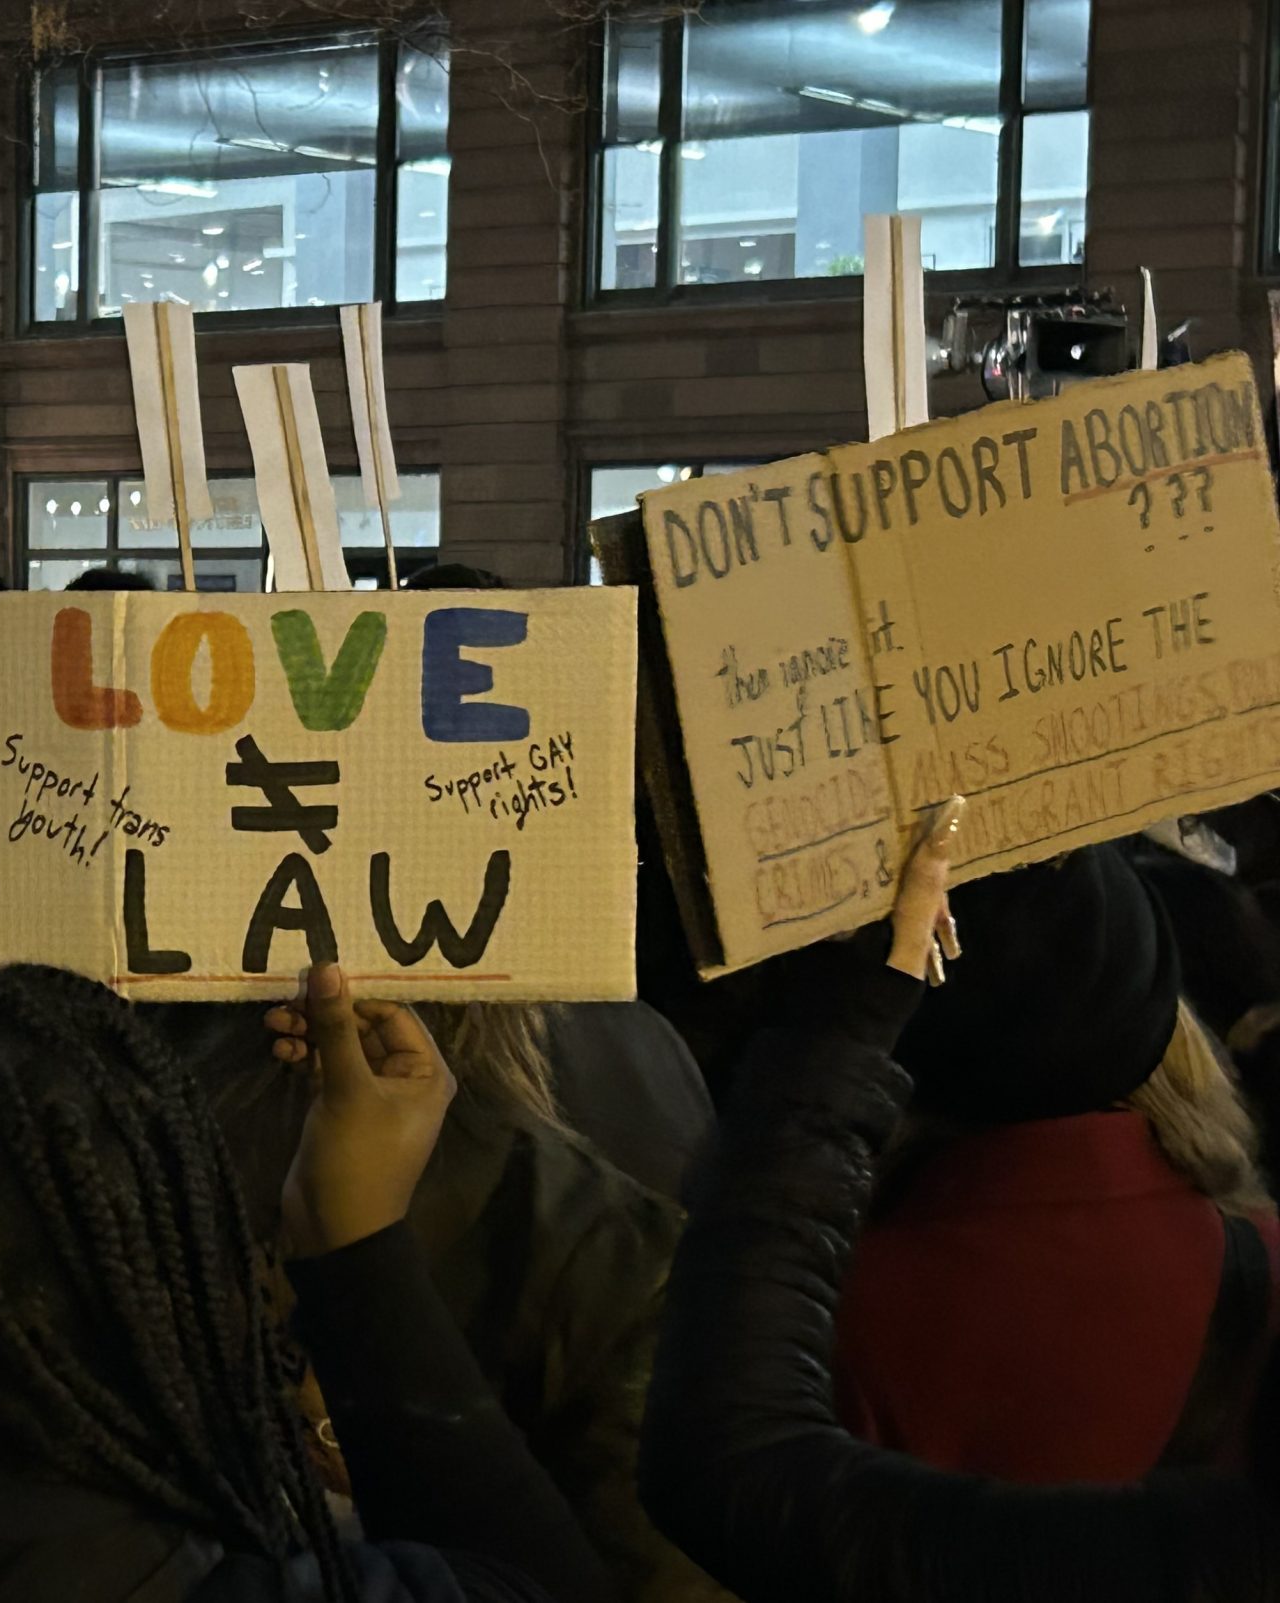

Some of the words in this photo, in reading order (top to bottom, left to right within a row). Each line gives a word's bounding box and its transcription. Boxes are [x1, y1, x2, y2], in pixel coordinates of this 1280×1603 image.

[664, 482, 792, 589] DON'T
[808, 428, 1037, 552] SUPPORT
[1061, 381, 1255, 495] ABORTION
[51, 607, 530, 742] LOVE
[731, 715, 807, 788] JUST
[821, 684, 901, 758] LIKE
[913, 662, 980, 726] YOU
[992, 618, 1128, 702] IGNORE
[1142, 592, 1215, 659] THE
[1, 734, 99, 806] Support
[110, 785, 170, 847] trans
[424, 751, 516, 814] Support
[529, 731, 574, 771] GAY
[490, 766, 577, 831] rights!
[911, 734, 1009, 806] MASS
[9, 799, 109, 867] youth!
[123, 850, 511, 974] LAW
